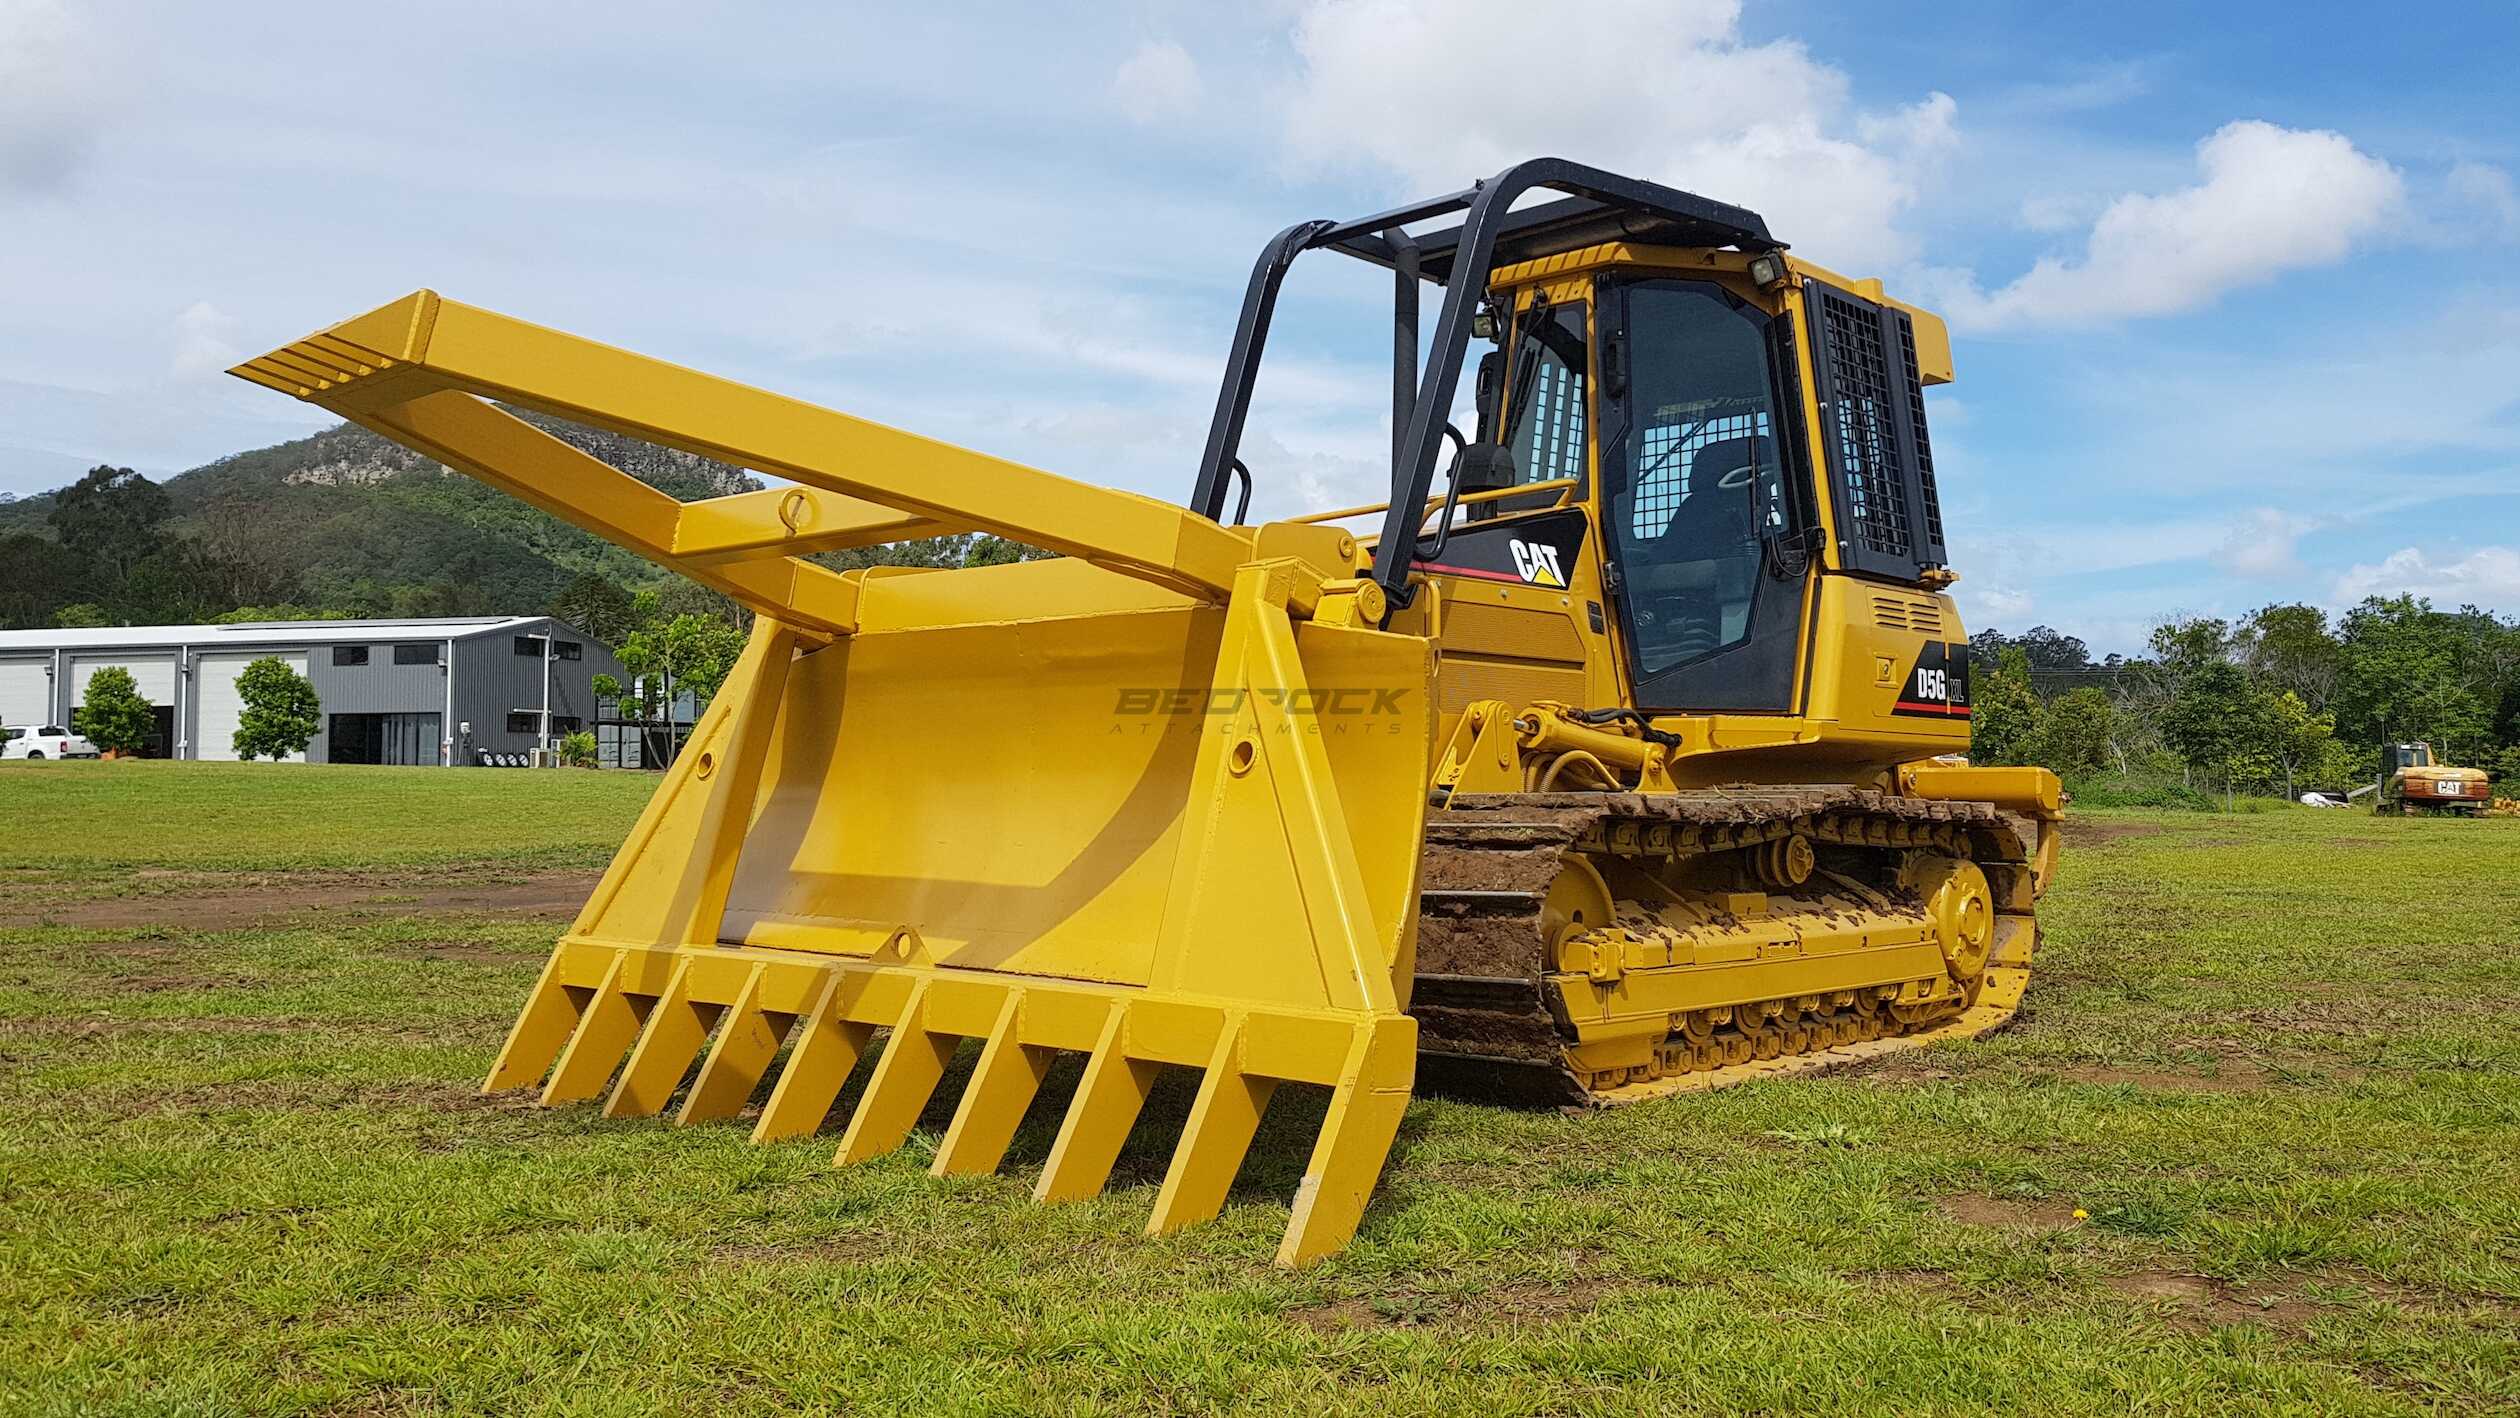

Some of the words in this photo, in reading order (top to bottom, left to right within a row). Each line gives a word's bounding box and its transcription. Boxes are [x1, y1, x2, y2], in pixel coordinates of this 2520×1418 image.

[1509, 539, 1566, 587] CAT
[1917, 668, 1946, 700] D5G
[1950, 678, 1964, 702] XL
[2437, 780, 2461, 795] CAT
